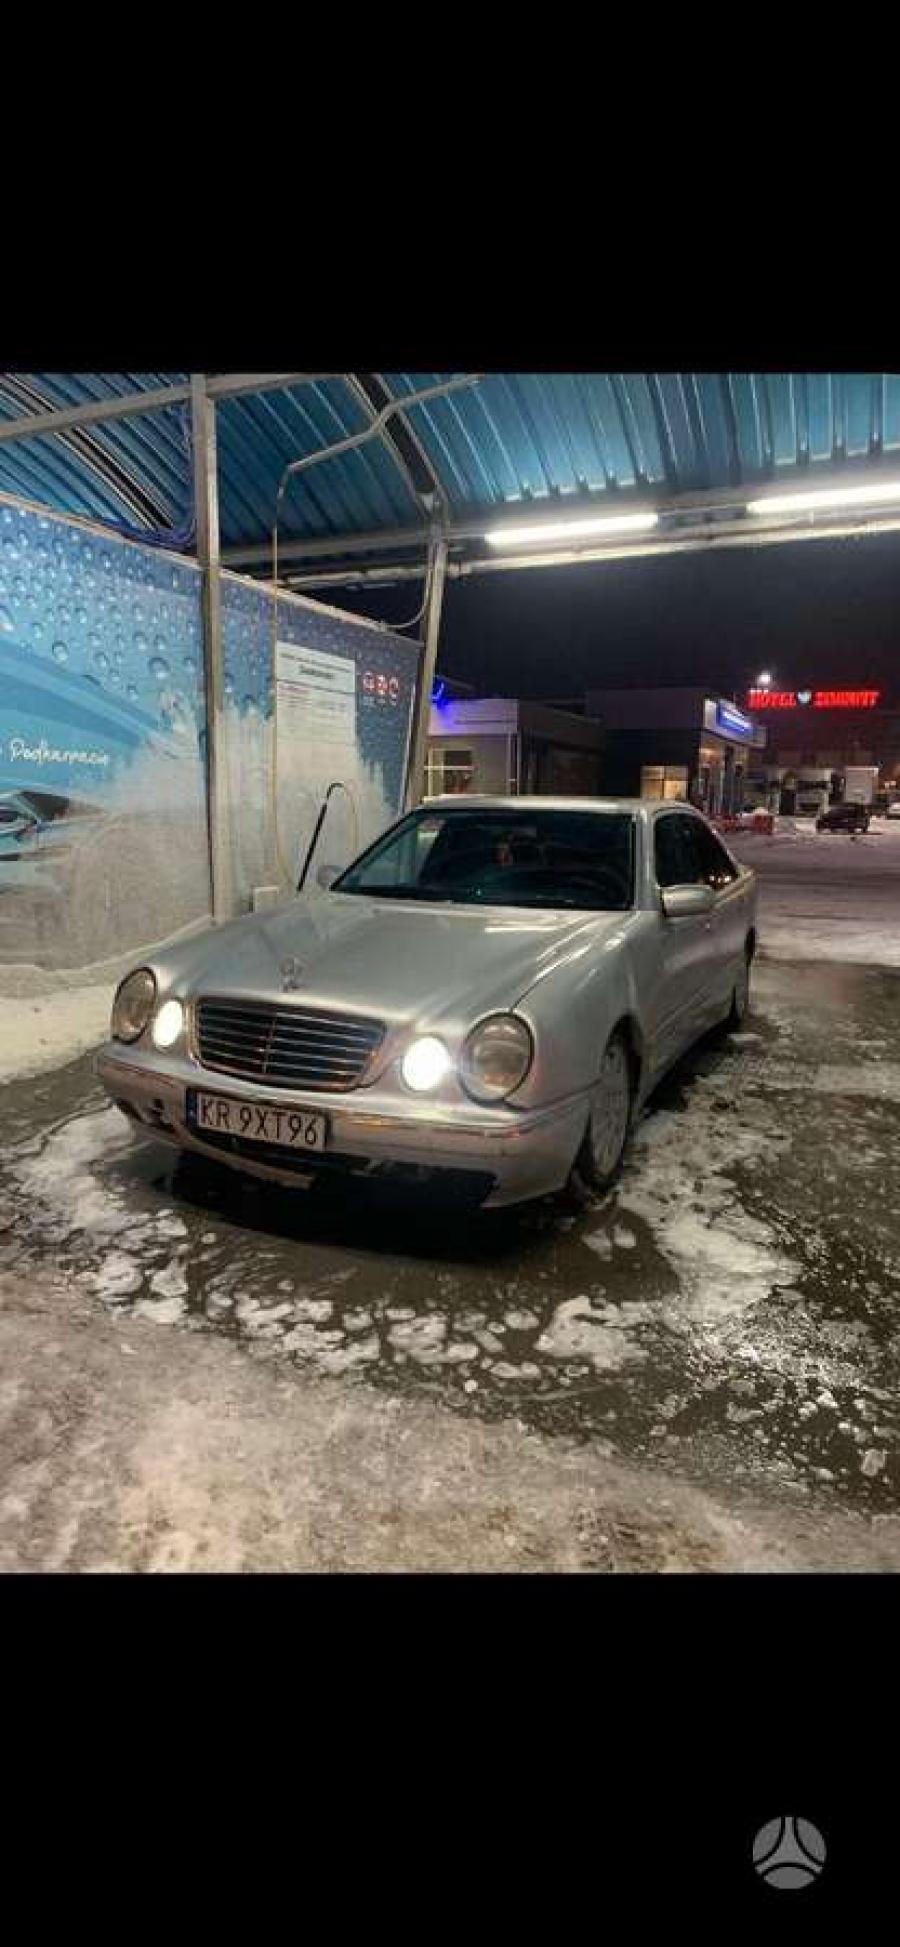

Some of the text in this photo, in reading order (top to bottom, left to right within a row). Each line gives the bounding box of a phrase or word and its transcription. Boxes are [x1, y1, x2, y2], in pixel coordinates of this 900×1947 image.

[748, 689, 796, 708] HOTEL
[201, 1100, 318, 1146] KR 9XT96
